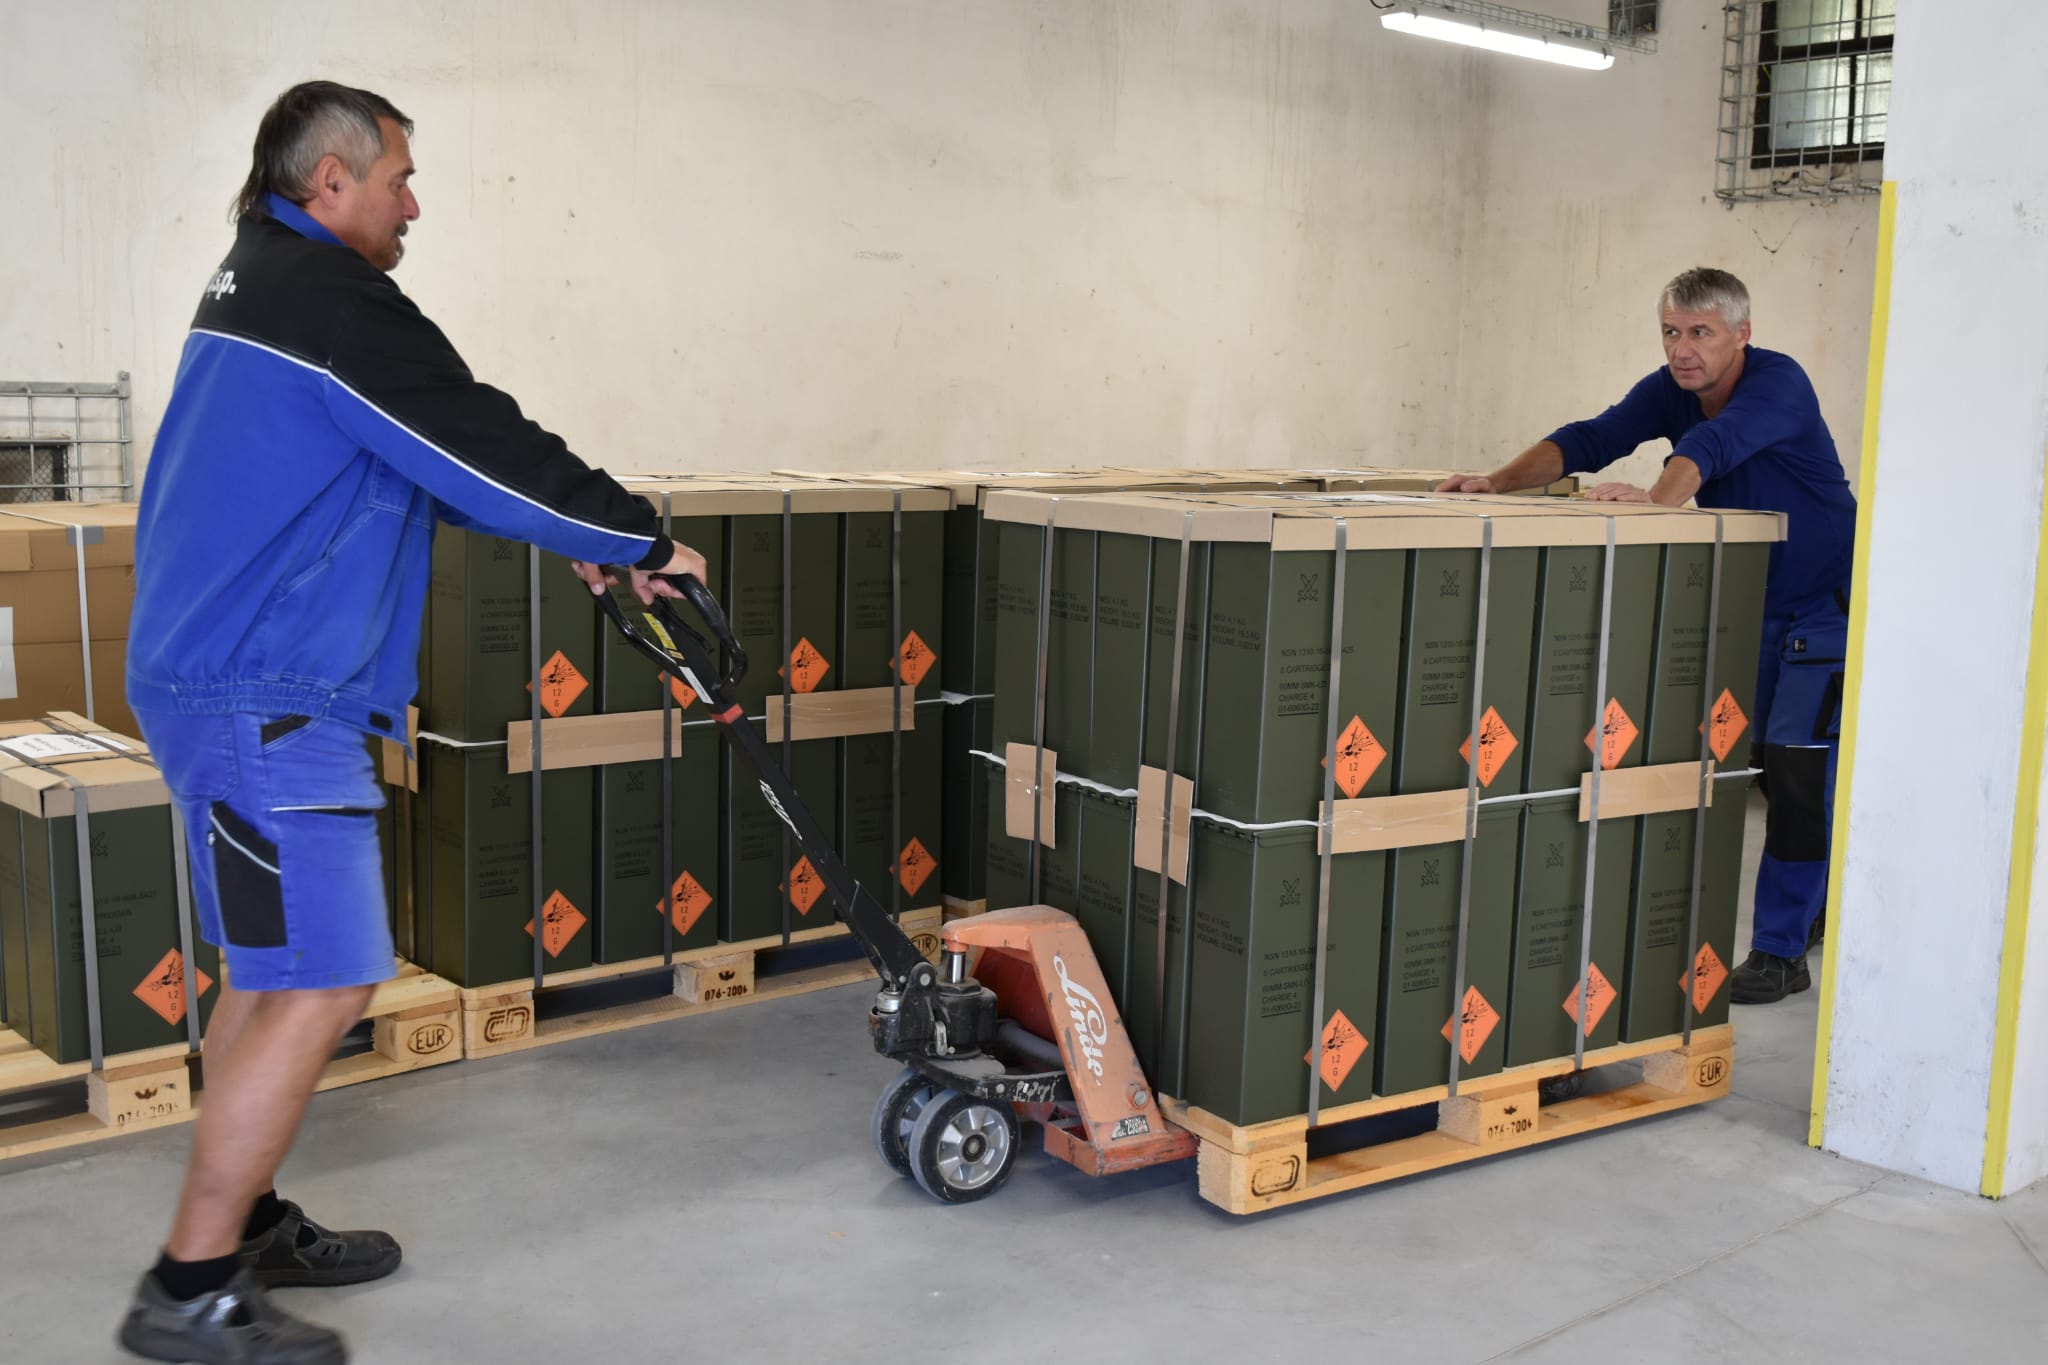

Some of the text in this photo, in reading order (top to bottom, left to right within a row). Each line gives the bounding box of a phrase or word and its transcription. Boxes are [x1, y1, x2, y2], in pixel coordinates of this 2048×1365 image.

[1053, 955, 1108, 1078] Linde
[415, 1028, 445, 1051] EUR
[1699, 1061, 1722, 1083] EUR
